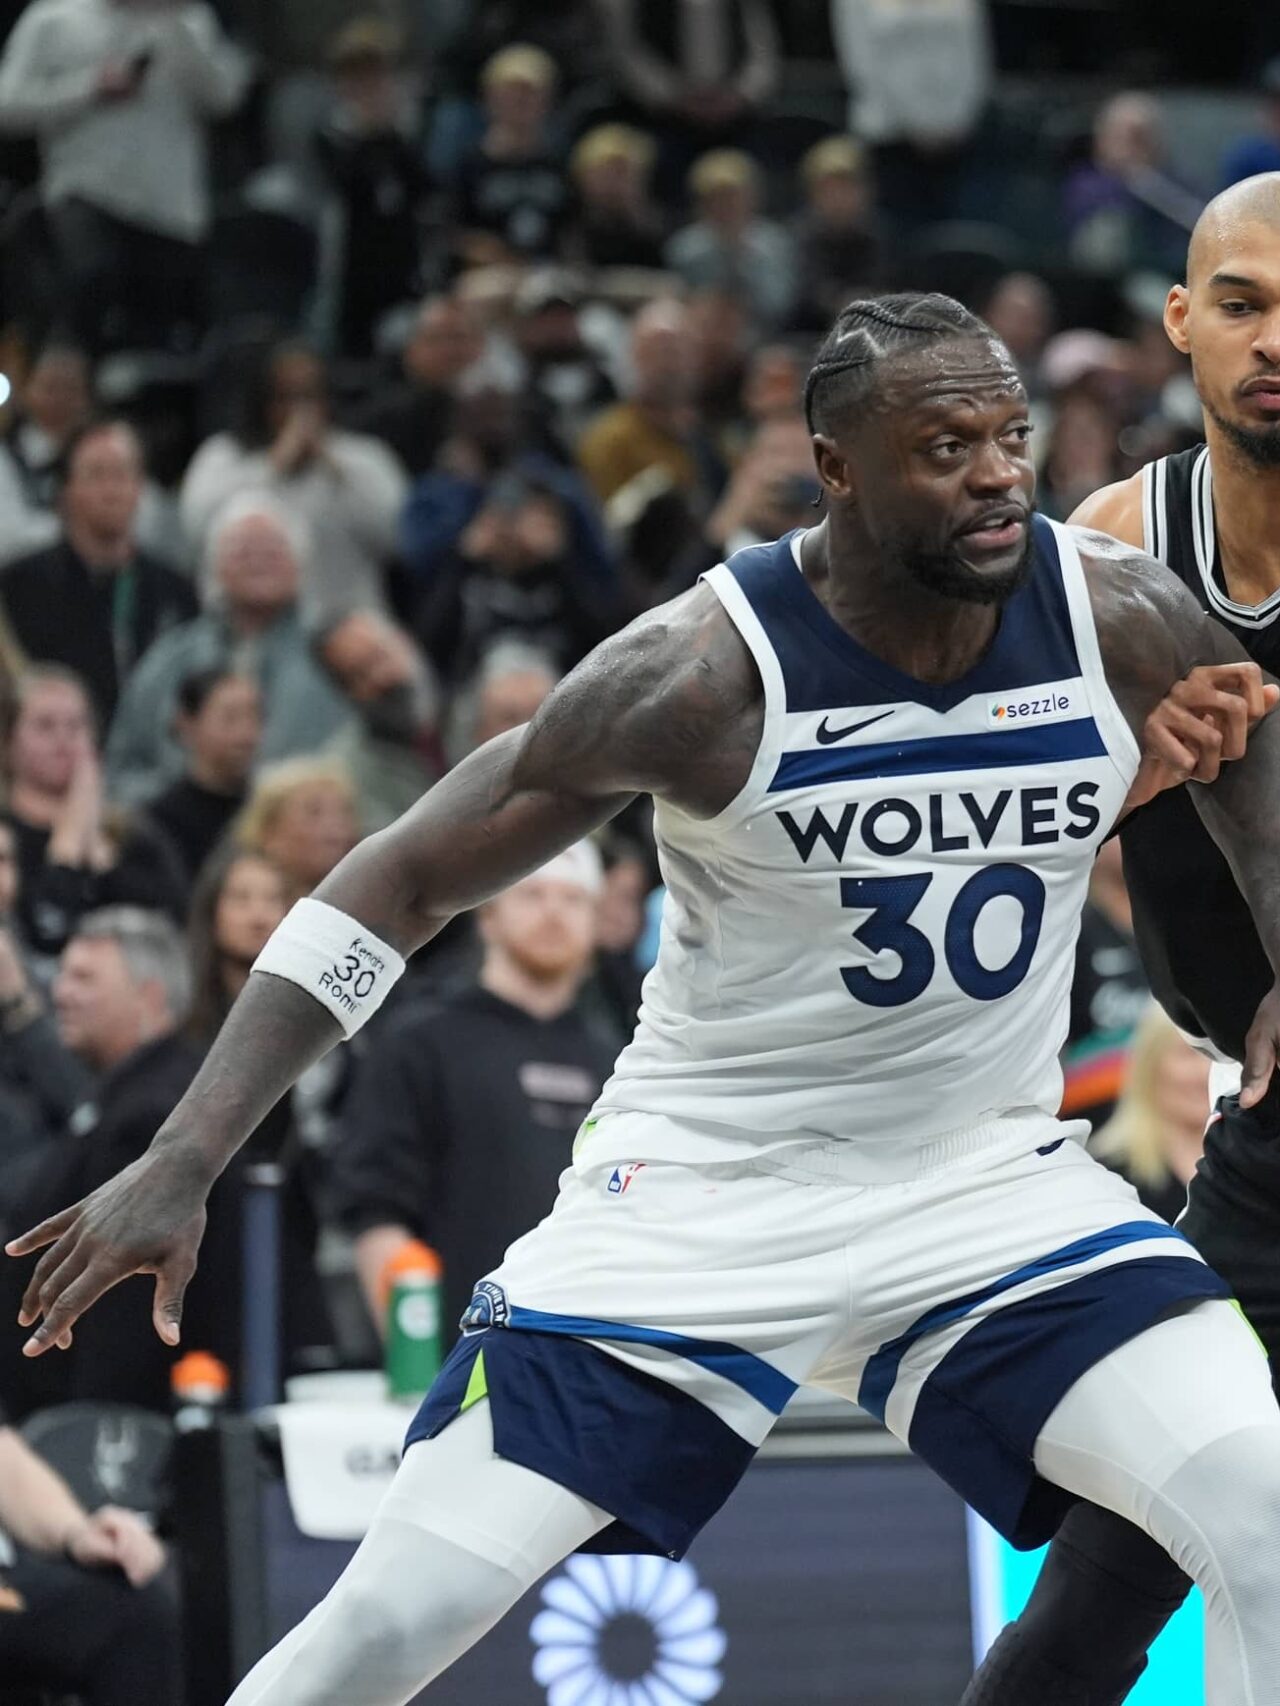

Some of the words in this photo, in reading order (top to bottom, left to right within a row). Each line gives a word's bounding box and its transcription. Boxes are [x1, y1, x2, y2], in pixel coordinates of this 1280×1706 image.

[1006, 692, 1070, 718] sezzle
[774, 781, 1101, 864] WOLVES
[839, 862, 1046, 1008] 30
[318, 971, 362, 1014] Romi
[333, 955, 376, 998] 30
